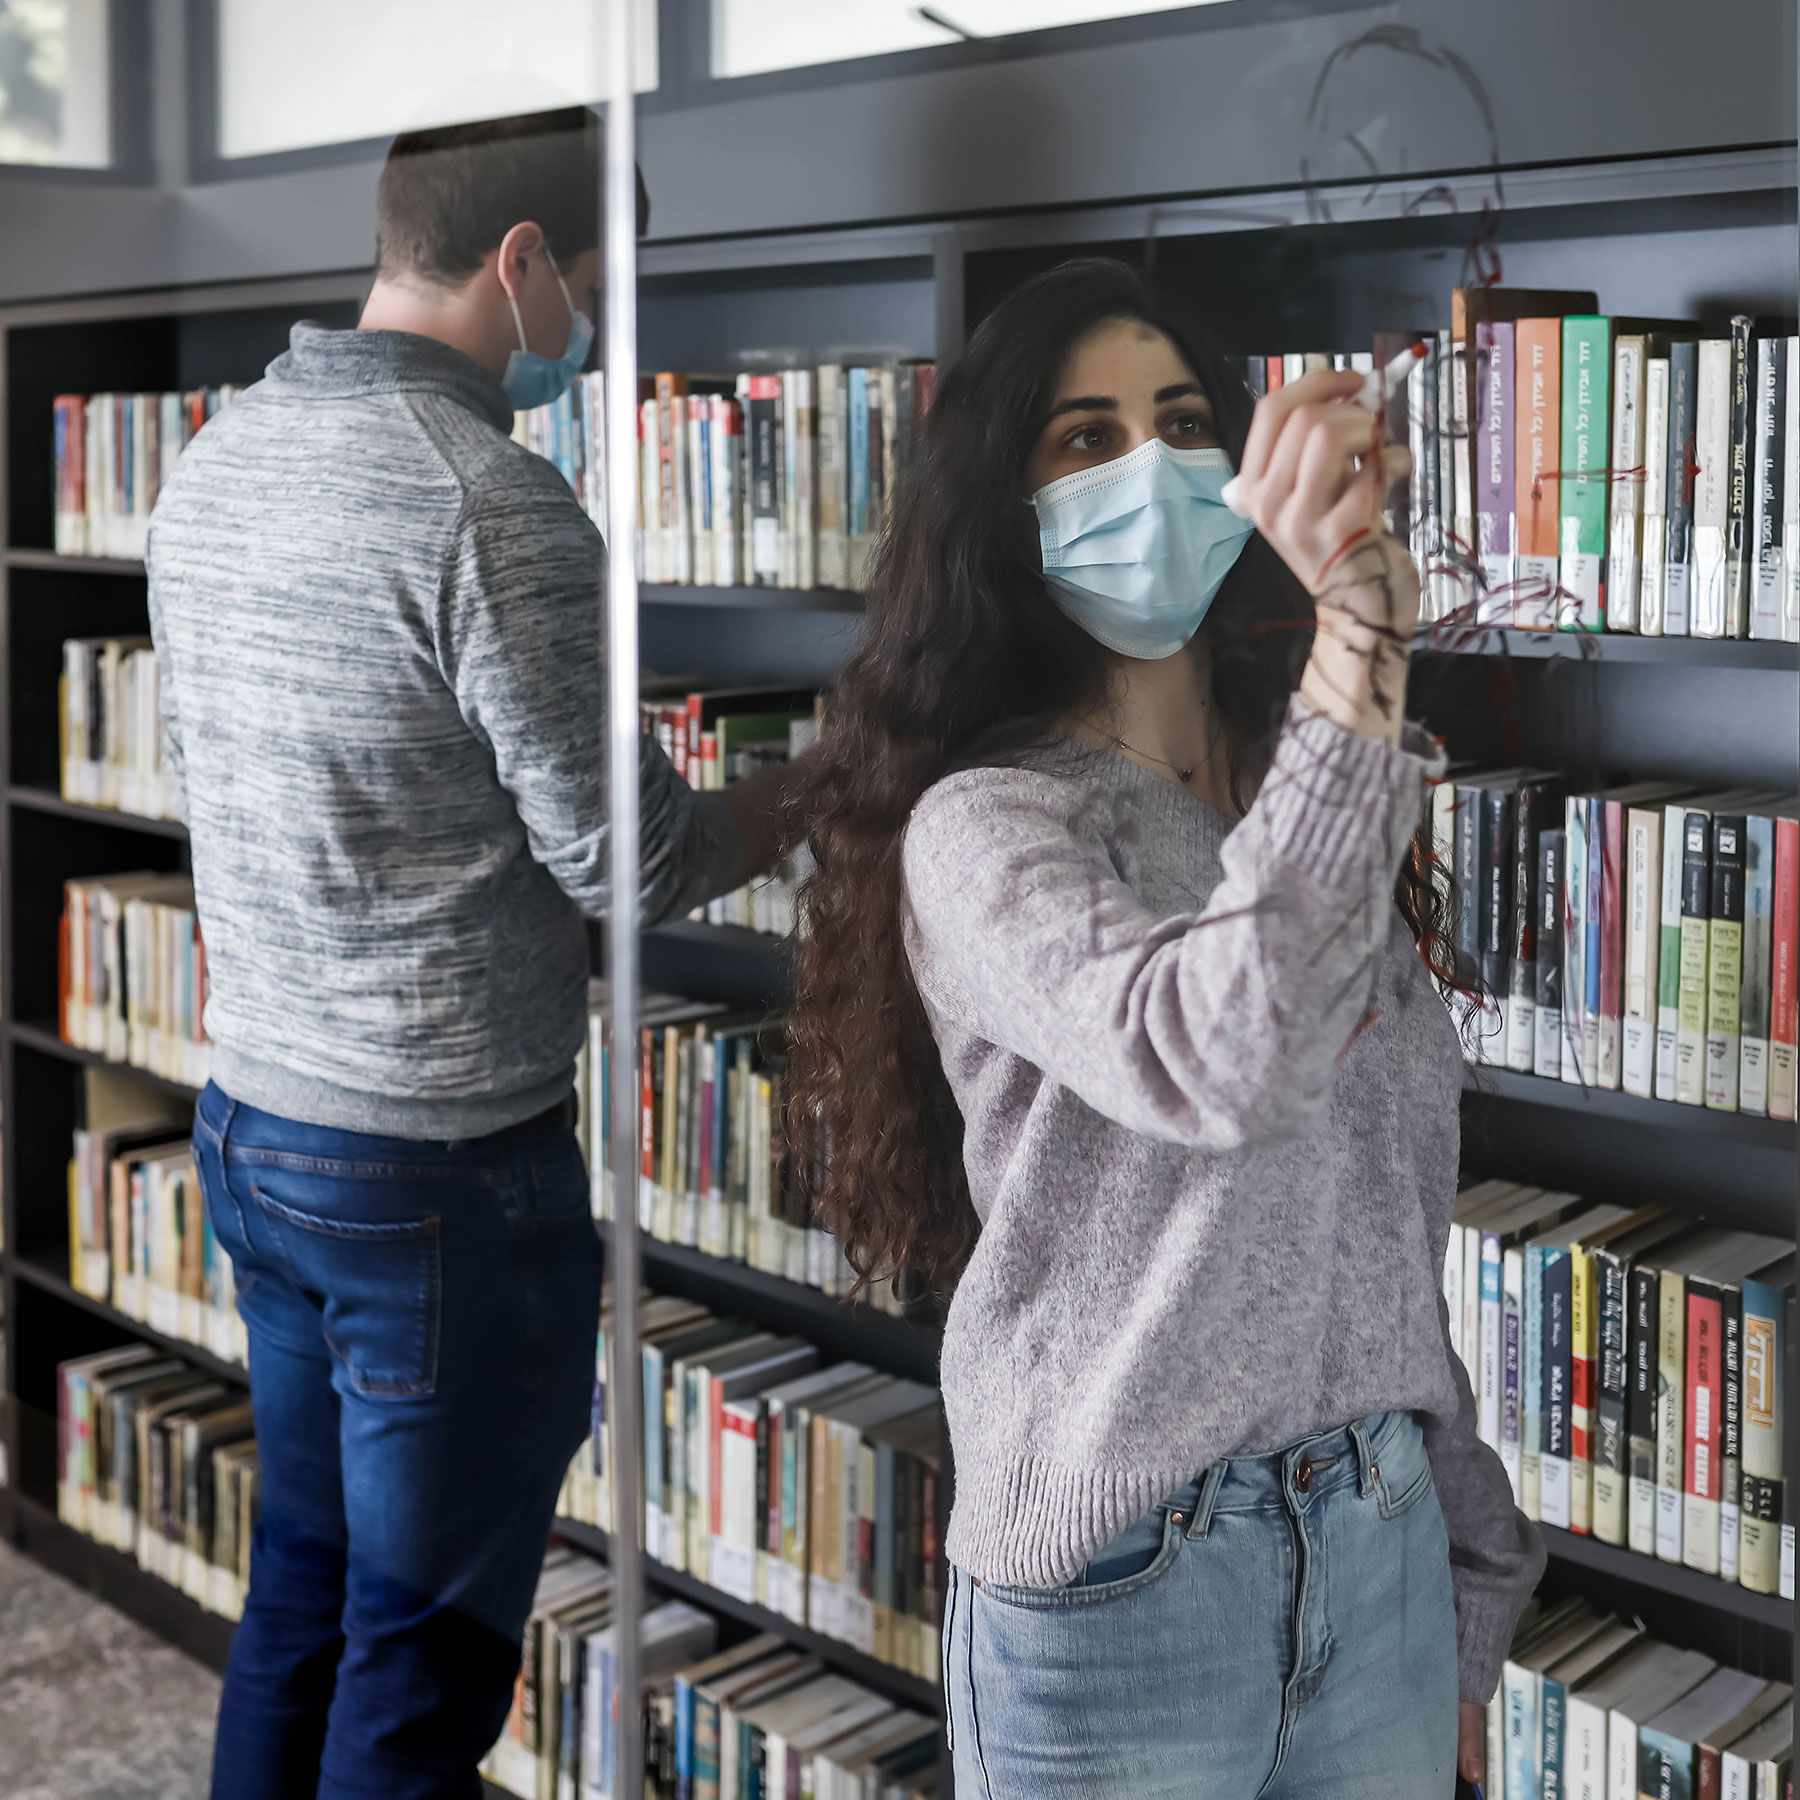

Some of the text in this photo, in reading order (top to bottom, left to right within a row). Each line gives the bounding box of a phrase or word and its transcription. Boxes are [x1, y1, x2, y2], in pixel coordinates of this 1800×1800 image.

[1491, 344, 1501, 367] דוד
[1532, 344, 1544, 367] דוד
[1578, 341, 1590, 364] דוד
[1490, 434, 1502, 484] השירים
[1532, 436, 1544, 487] השירים
[1577, 433, 1590, 484] השירים
